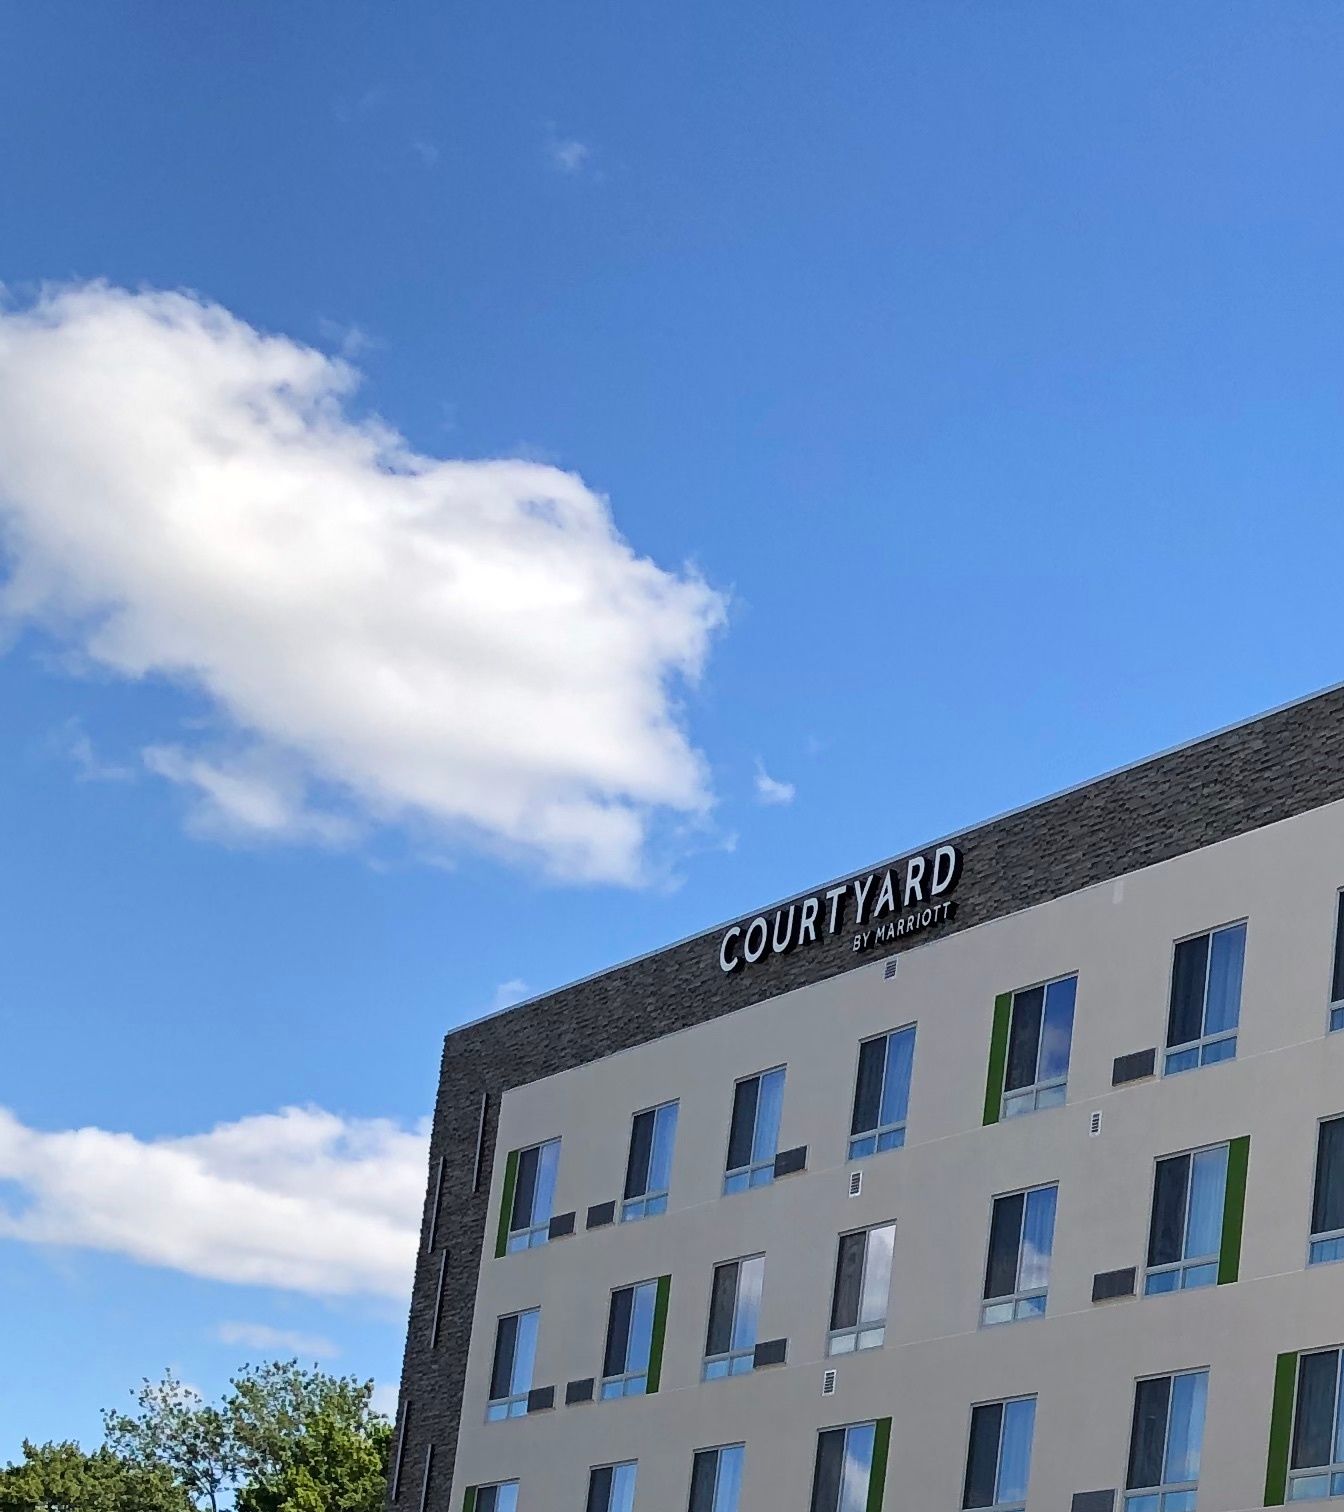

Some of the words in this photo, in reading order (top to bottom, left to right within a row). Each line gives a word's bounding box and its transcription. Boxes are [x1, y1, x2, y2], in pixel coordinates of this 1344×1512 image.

[720, 845, 957, 973] COURTYARD
[853, 931, 872, 951] BY
[875, 901, 952, 944] MARRIOTT
